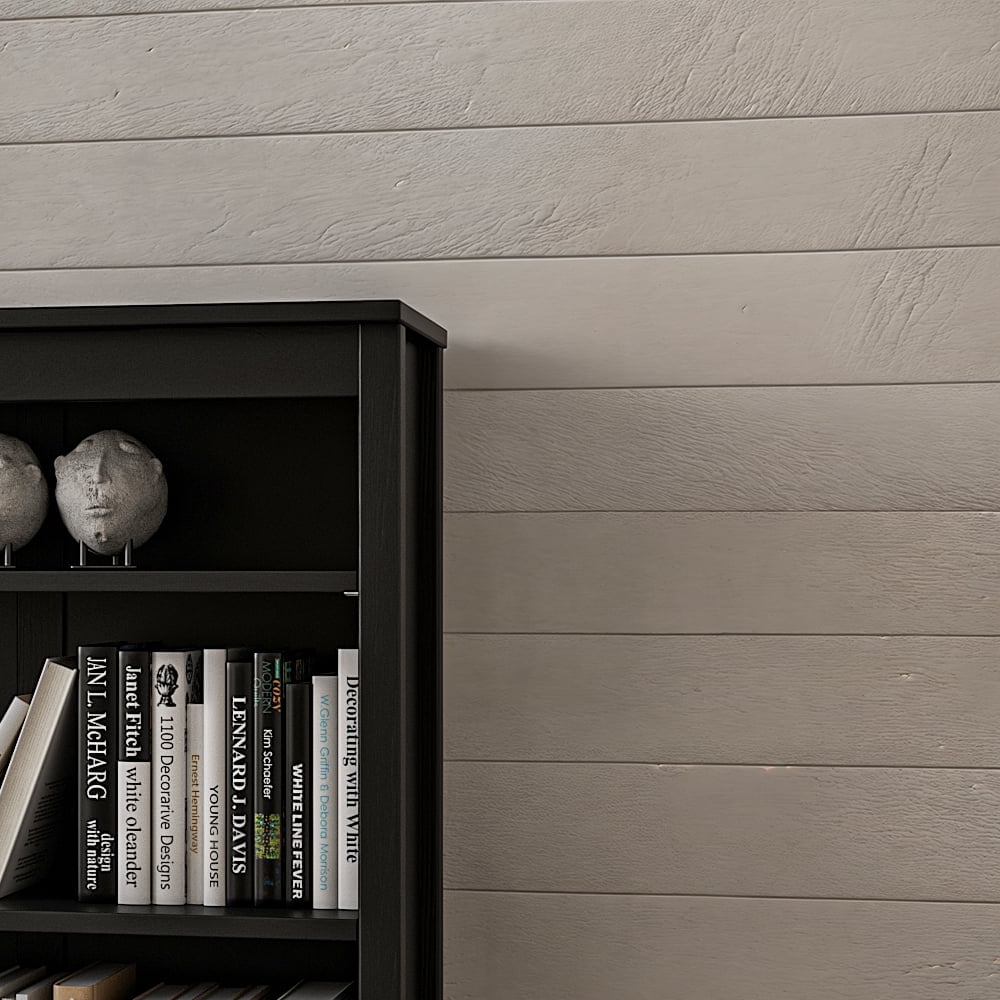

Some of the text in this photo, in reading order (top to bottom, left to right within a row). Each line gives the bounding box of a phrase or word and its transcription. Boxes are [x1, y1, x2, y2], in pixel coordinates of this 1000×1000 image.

[125, 665, 142, 758] Janet Fitch
[262, 661, 272, 714] MODERN
[86, 657, 107, 800] JAN L. McHARG
[160, 716, 174, 750] 1100
[231, 696, 247, 874] LENNARD J. DAVIS
[263, 728, 273, 799] Kim Schaefer
[292, 763, 303, 812] WHITE
[320, 746, 329, 780] Griffin
[343, 676, 359, 863] Decorating with White
[125, 766, 142, 888] white oleander
[190, 754, 200, 854] Ernest Hemingway
[320, 795, 329, 839] Debora
[86, 819, 100, 890] with nature
[97, 833, 115, 872] design
[157, 835, 174, 890] Designs
[209, 785, 219, 888] YOUNG HOUSE
[320, 843, 329, 891] Morrison
[292, 850, 303, 899] FEVER
